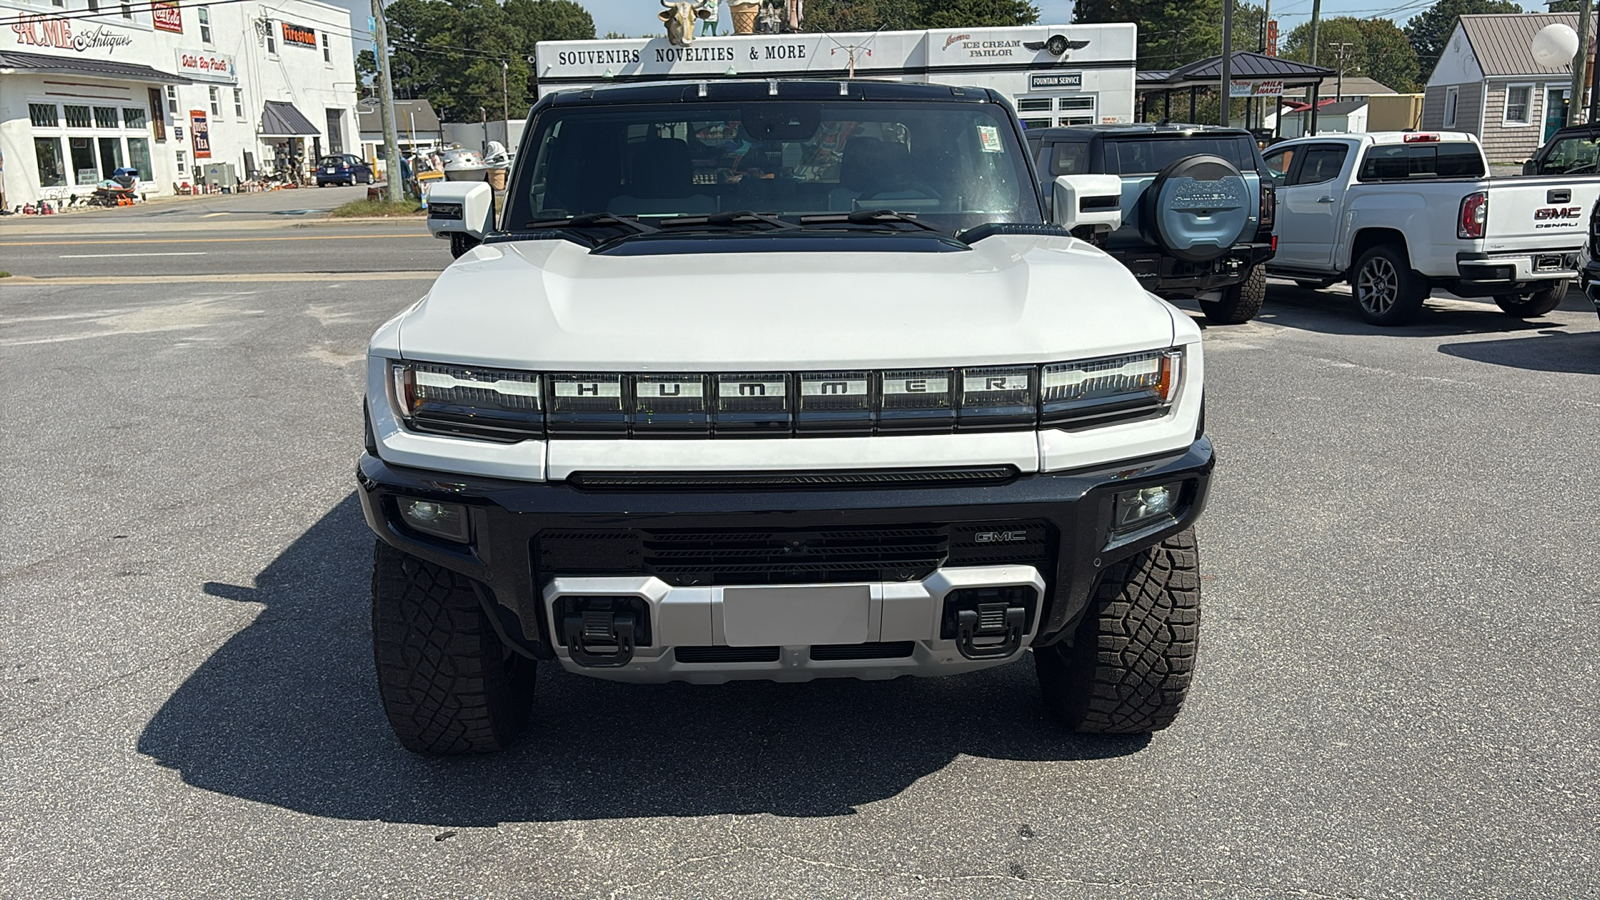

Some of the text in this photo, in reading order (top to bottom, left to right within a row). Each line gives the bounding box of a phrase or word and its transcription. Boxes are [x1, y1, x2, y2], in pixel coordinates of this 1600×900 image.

[12, 11, 133, 54] ACME Antiques
[963, 40, 1021, 49] ICE CREAM
[558, 45, 806, 66] SOUVENIRS NOVELTIES & MORE
[970, 49, 1013, 57] PARLOR
[1033, 76, 1080, 86] FOUNTAIN SERVICE
[196, 137, 208, 149] TEA
[1534, 207, 1581, 220] GMC
[577, 377, 1007, 397] HUMMER
[974, 530, 1027, 543] GMC
